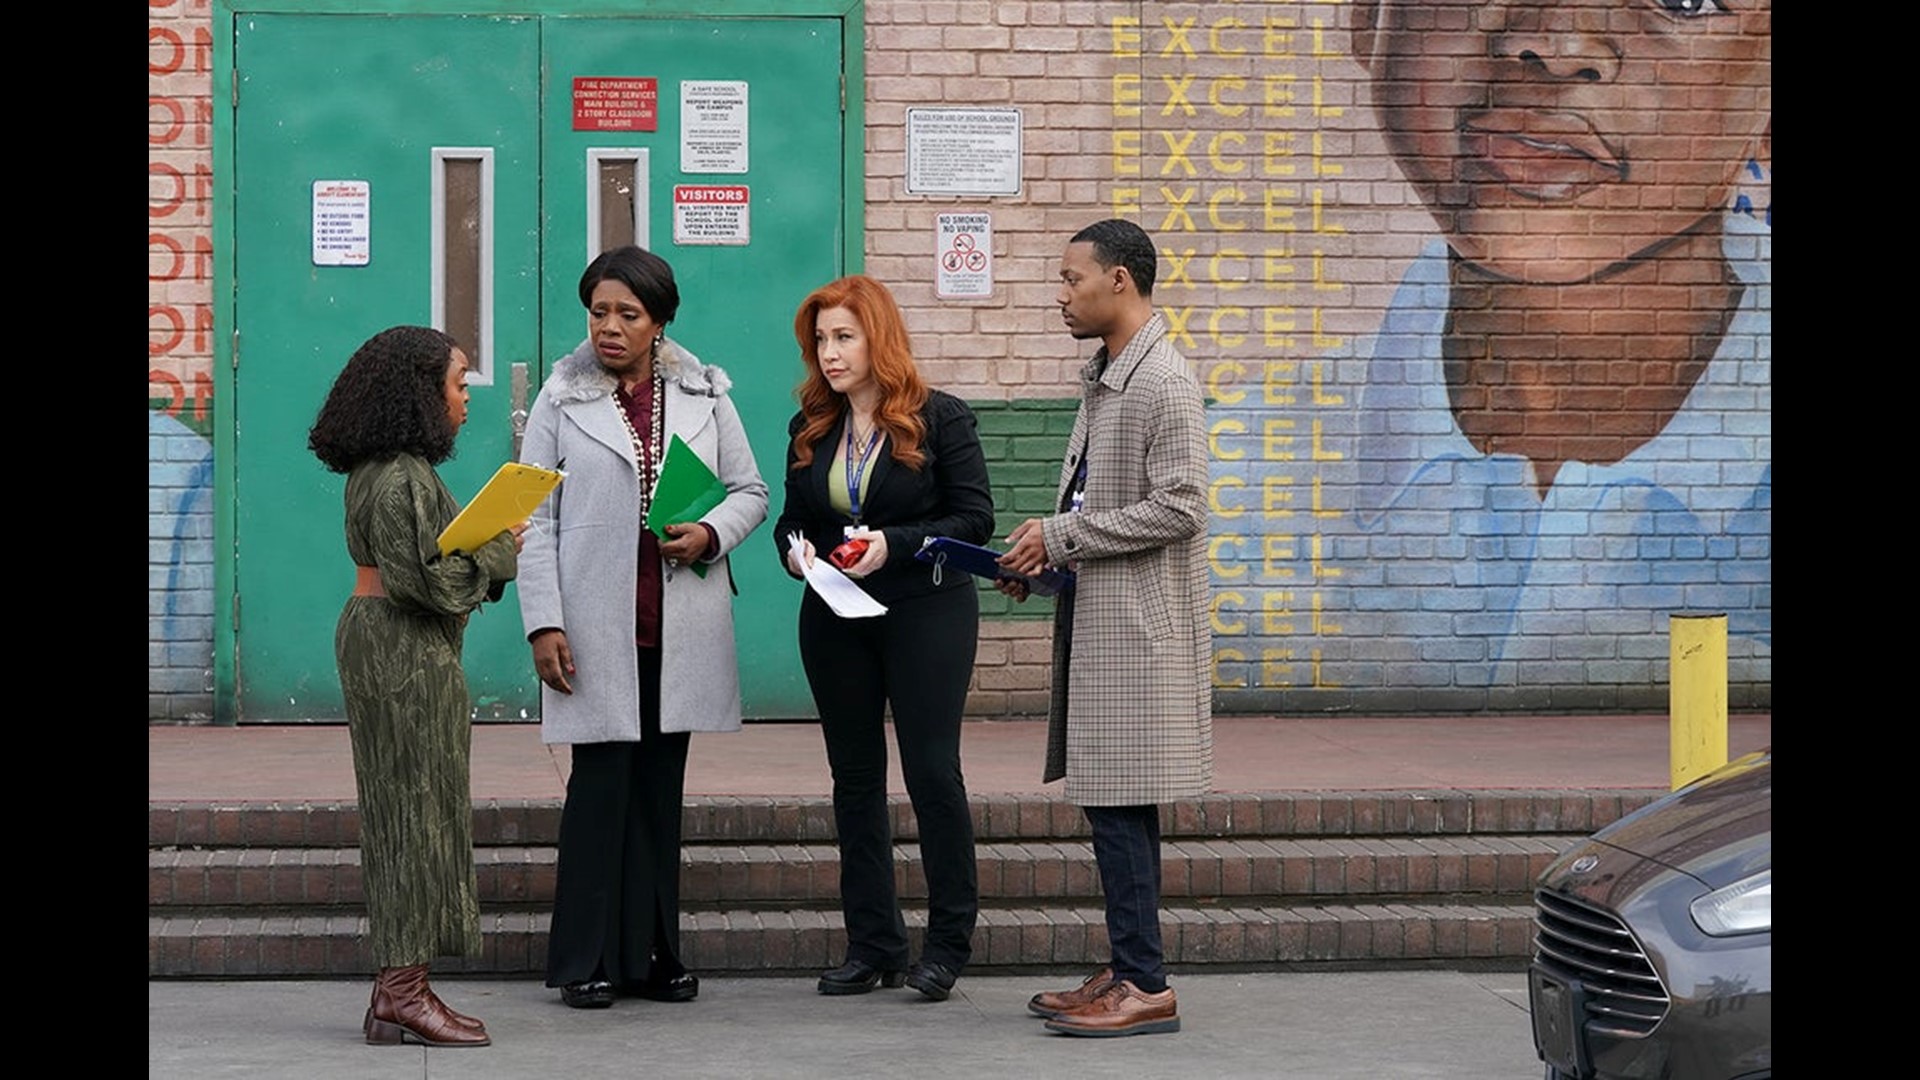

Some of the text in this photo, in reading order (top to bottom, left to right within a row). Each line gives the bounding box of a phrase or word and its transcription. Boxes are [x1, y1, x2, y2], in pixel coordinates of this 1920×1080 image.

[1112, 17, 1344, 60] EXCEL
[1112, 73, 1344, 117] EXCEL
[1112, 131, 1344, 175] EXCEL
[680, 190, 744, 200] VISITORS
[1112, 187, 1344, 234] EXCEL
[1161, 248, 1344, 290] XCEL
[1164, 306, 1344, 348] XCEL
[1208, 360, 1344, 405] CEL
[1208, 418, 1344, 461] CEL
[1208, 476, 1343, 520] CEL
[1208, 532, 1342, 578] CEL
[1210, 591, 1342, 635] CEL
[1211, 648, 1342, 692] CEL
